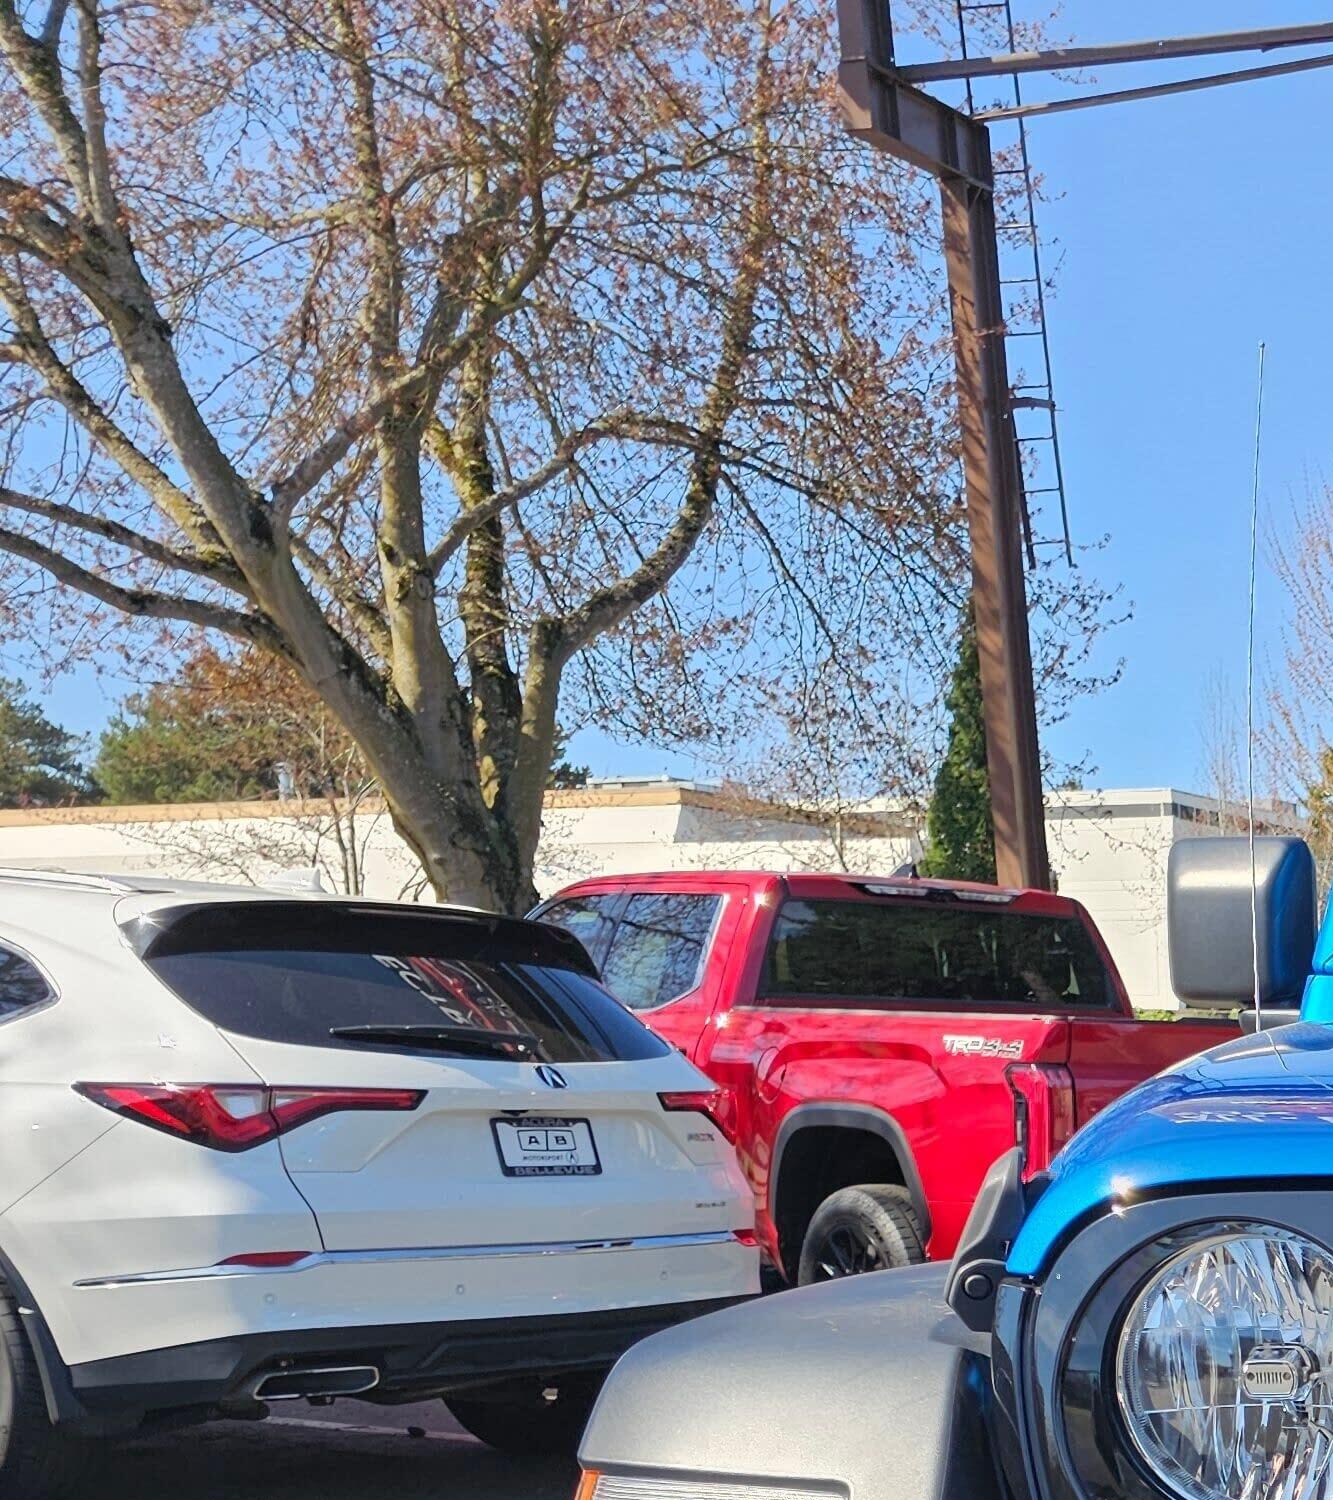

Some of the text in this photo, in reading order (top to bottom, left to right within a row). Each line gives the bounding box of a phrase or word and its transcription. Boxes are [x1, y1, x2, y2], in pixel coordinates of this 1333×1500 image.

[943, 1034, 984, 1054] TRD
[521, 1118, 566, 1127] ACURA
[523, 1154, 563, 1162] MOTORSPORT
[514, 1166, 595, 1176] BELLEVUE
